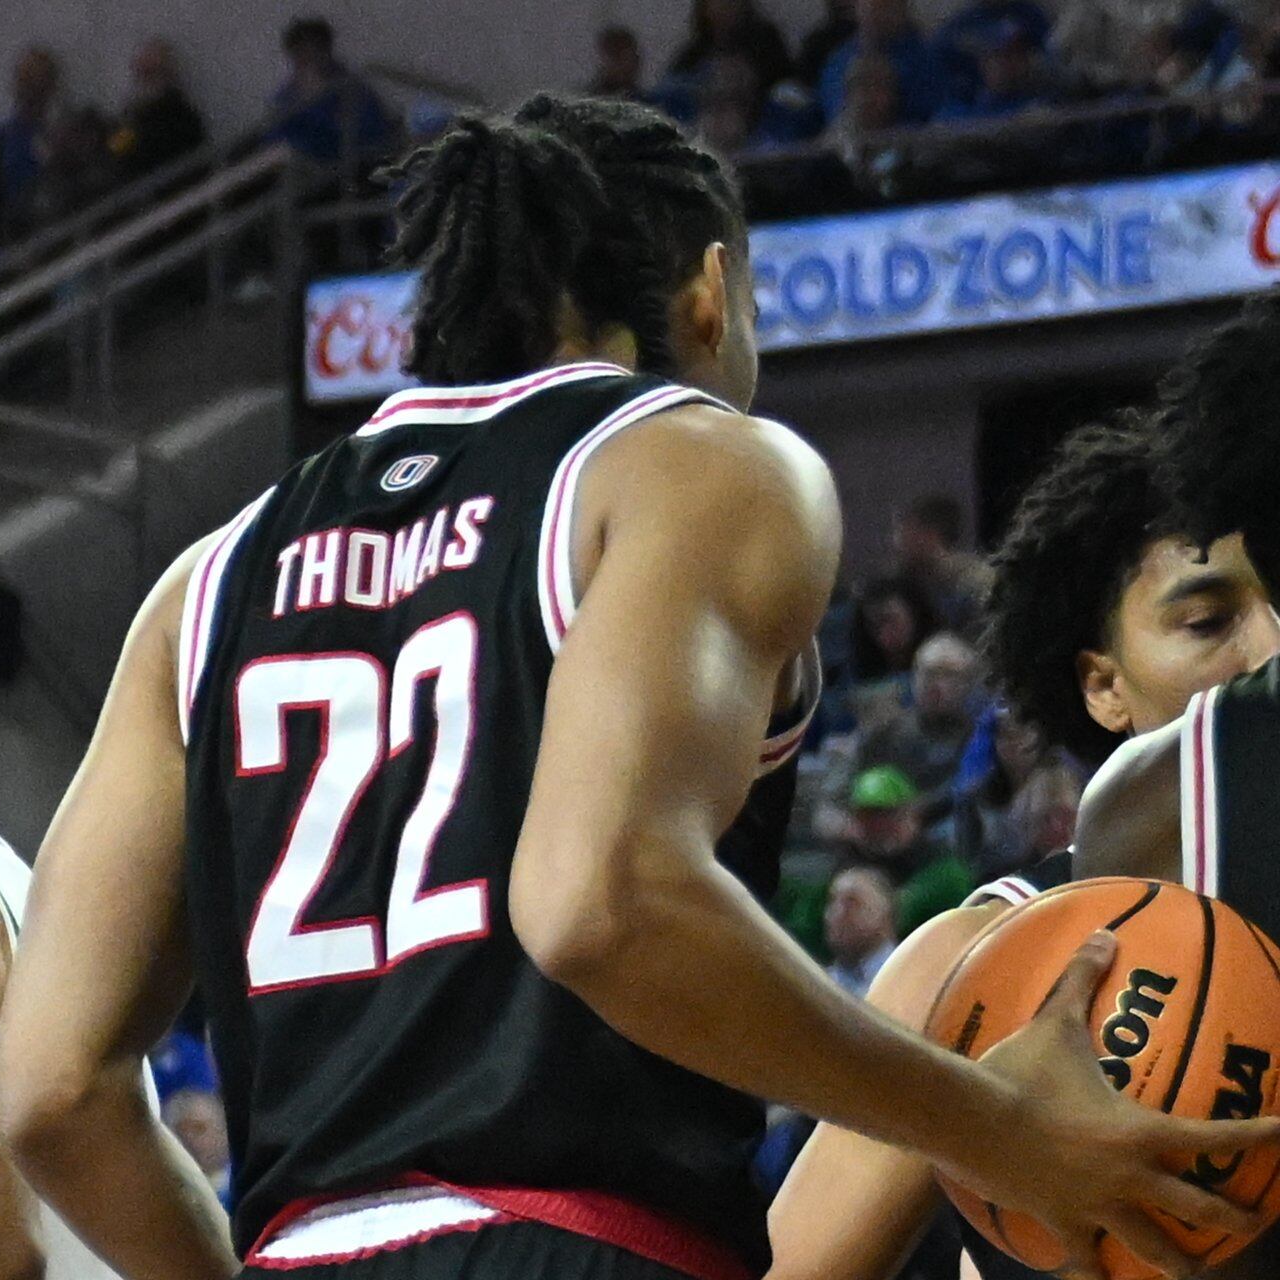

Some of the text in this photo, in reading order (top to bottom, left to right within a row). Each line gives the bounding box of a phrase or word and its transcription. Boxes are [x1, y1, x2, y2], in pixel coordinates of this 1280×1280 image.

[954, 212, 1155, 306] ZONE
[272, 496, 494, 621] THOMAS
[236, 609, 490, 997] 22
